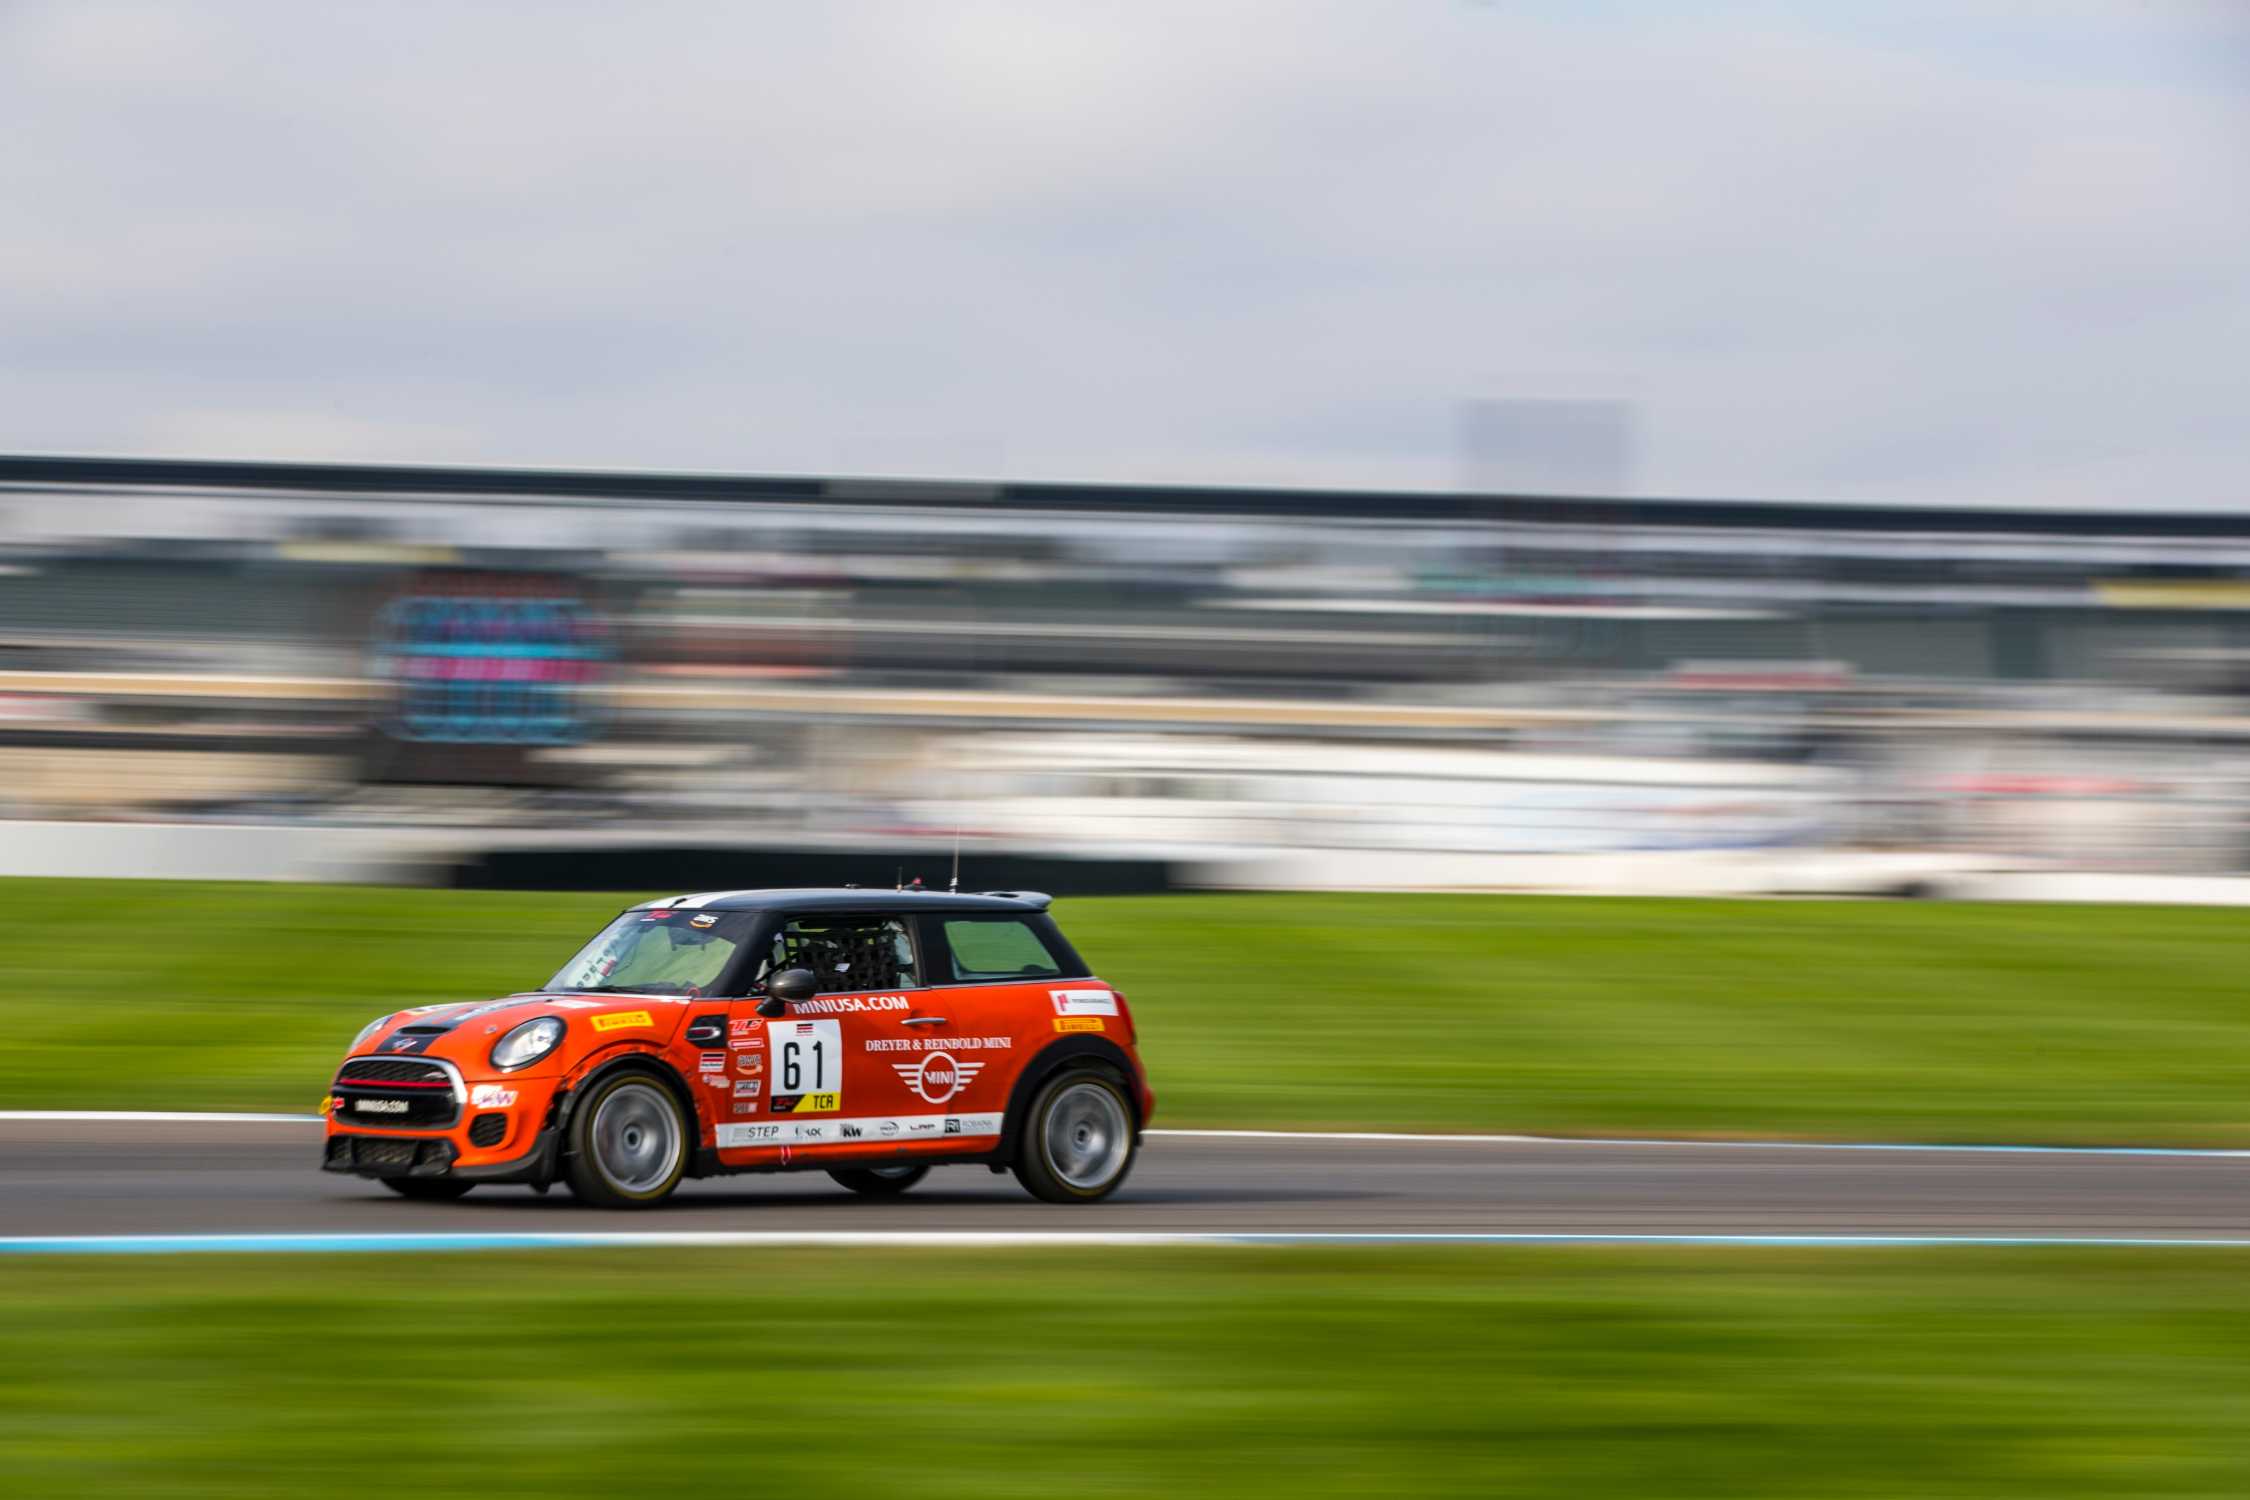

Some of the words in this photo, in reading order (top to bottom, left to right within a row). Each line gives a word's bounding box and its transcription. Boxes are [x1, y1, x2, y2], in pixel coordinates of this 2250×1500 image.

[793, 996, 910, 1014] MINIUSA.COM
[865, 1039, 911, 1051] DREYER
[912, 1039, 922, 1050] &
[924, 1037, 982, 1050] REINBOLD
[983, 1037, 1011, 1049] MINI
[784, 1041, 823, 1090] 61
[924, 1071, 954, 1084] MINI
[813, 1095, 834, 1109] TCA
[748, 1126, 780, 1138] STEP
